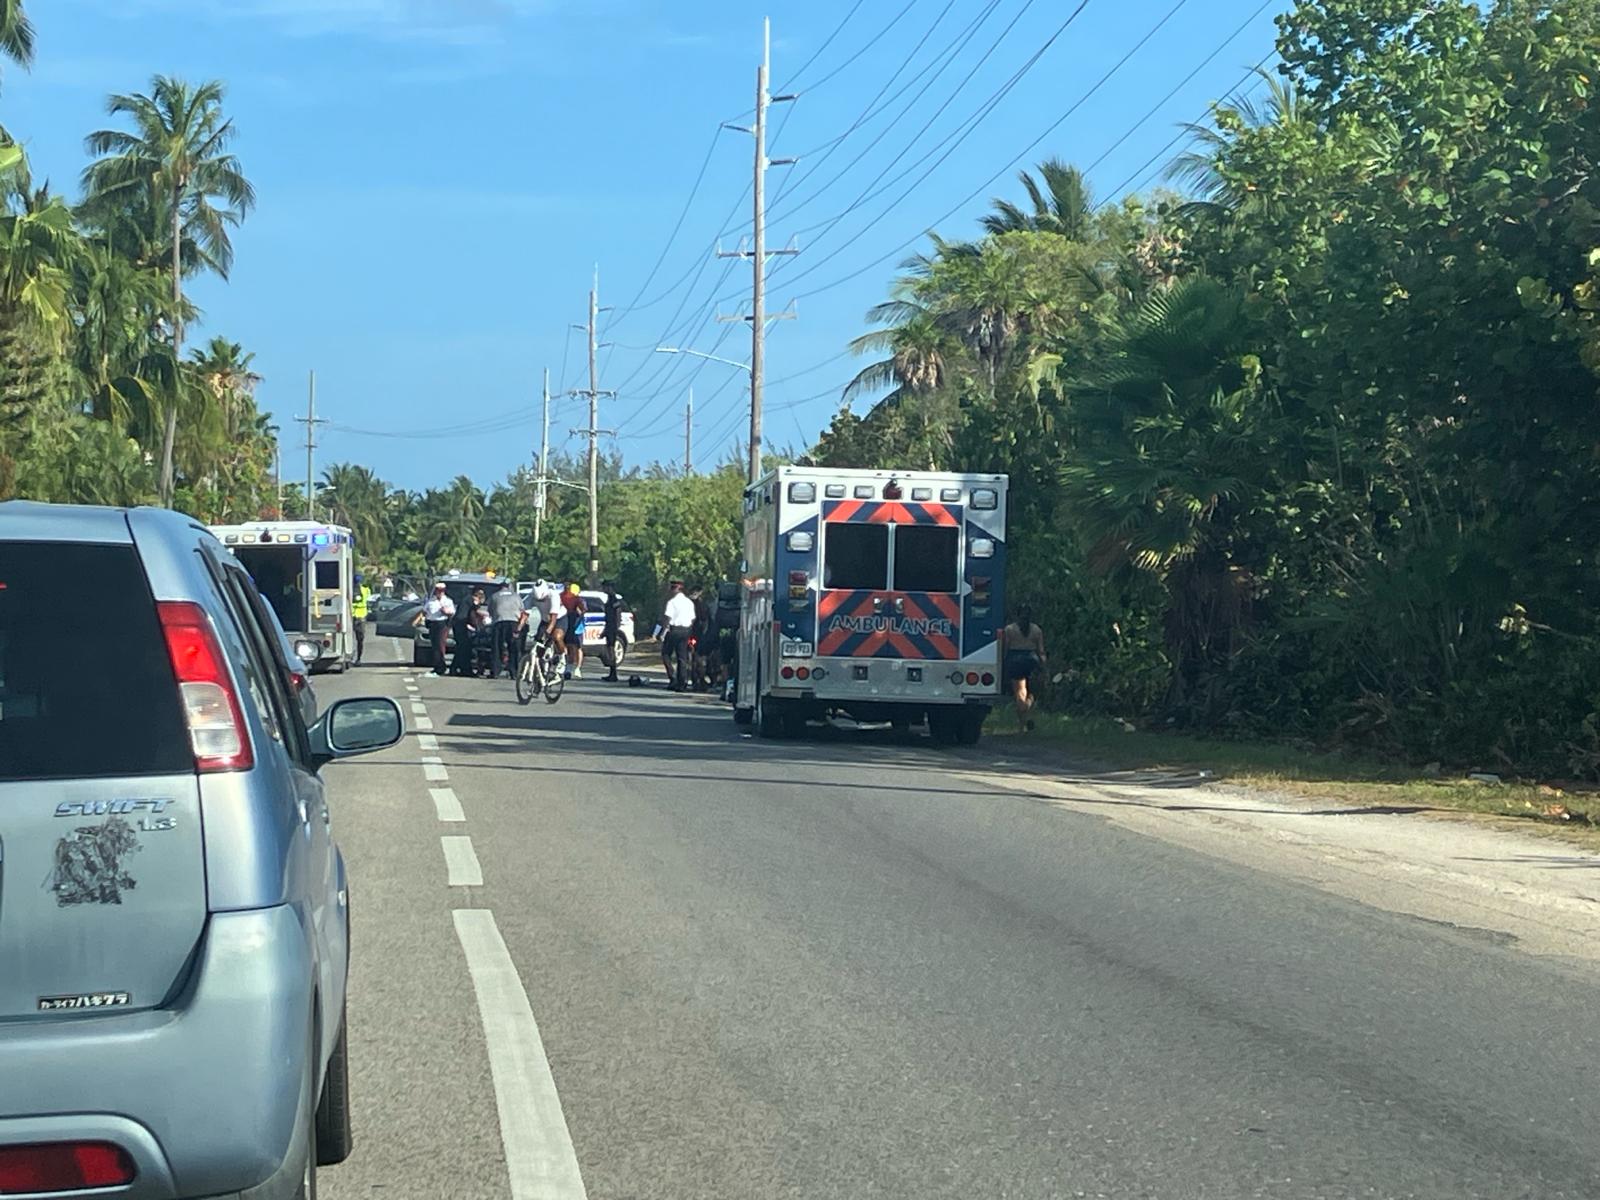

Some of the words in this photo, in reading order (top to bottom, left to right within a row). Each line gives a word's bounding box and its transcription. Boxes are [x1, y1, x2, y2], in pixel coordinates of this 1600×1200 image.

[829, 615, 952, 636] AMBULANCE
[54, 798, 176, 817] SWIFT
[137, 816, 176, 831] 1.3
